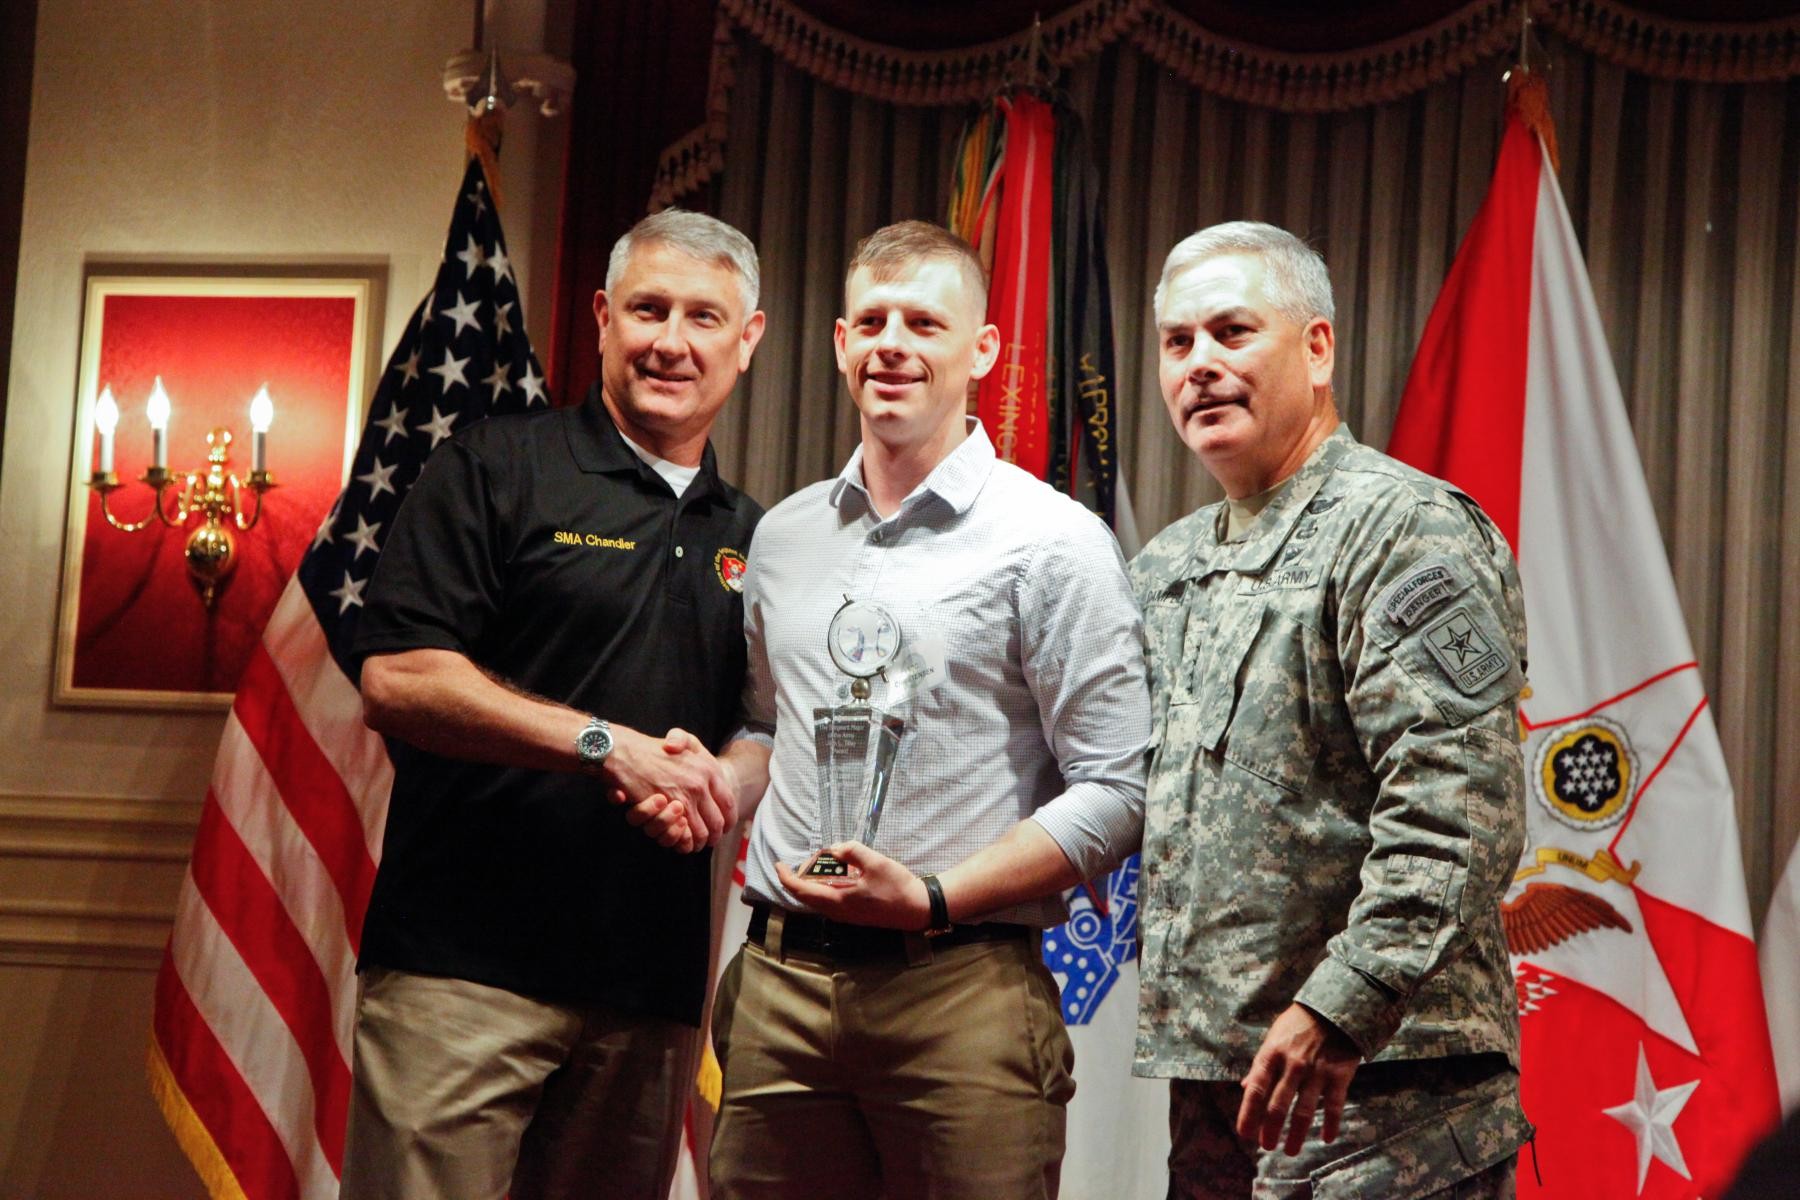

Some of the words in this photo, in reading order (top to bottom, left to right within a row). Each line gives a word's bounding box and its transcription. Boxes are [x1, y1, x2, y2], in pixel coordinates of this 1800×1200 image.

[554, 531, 582, 545] SMA
[585, 534, 635, 549] Chandler
[1277, 570, 1312, 585] ARMY
[1388, 584, 1415, 613] SPECIAL
[1413, 570, 1445, 591] FORCES
[1406, 587, 1442, 619] RANGER
